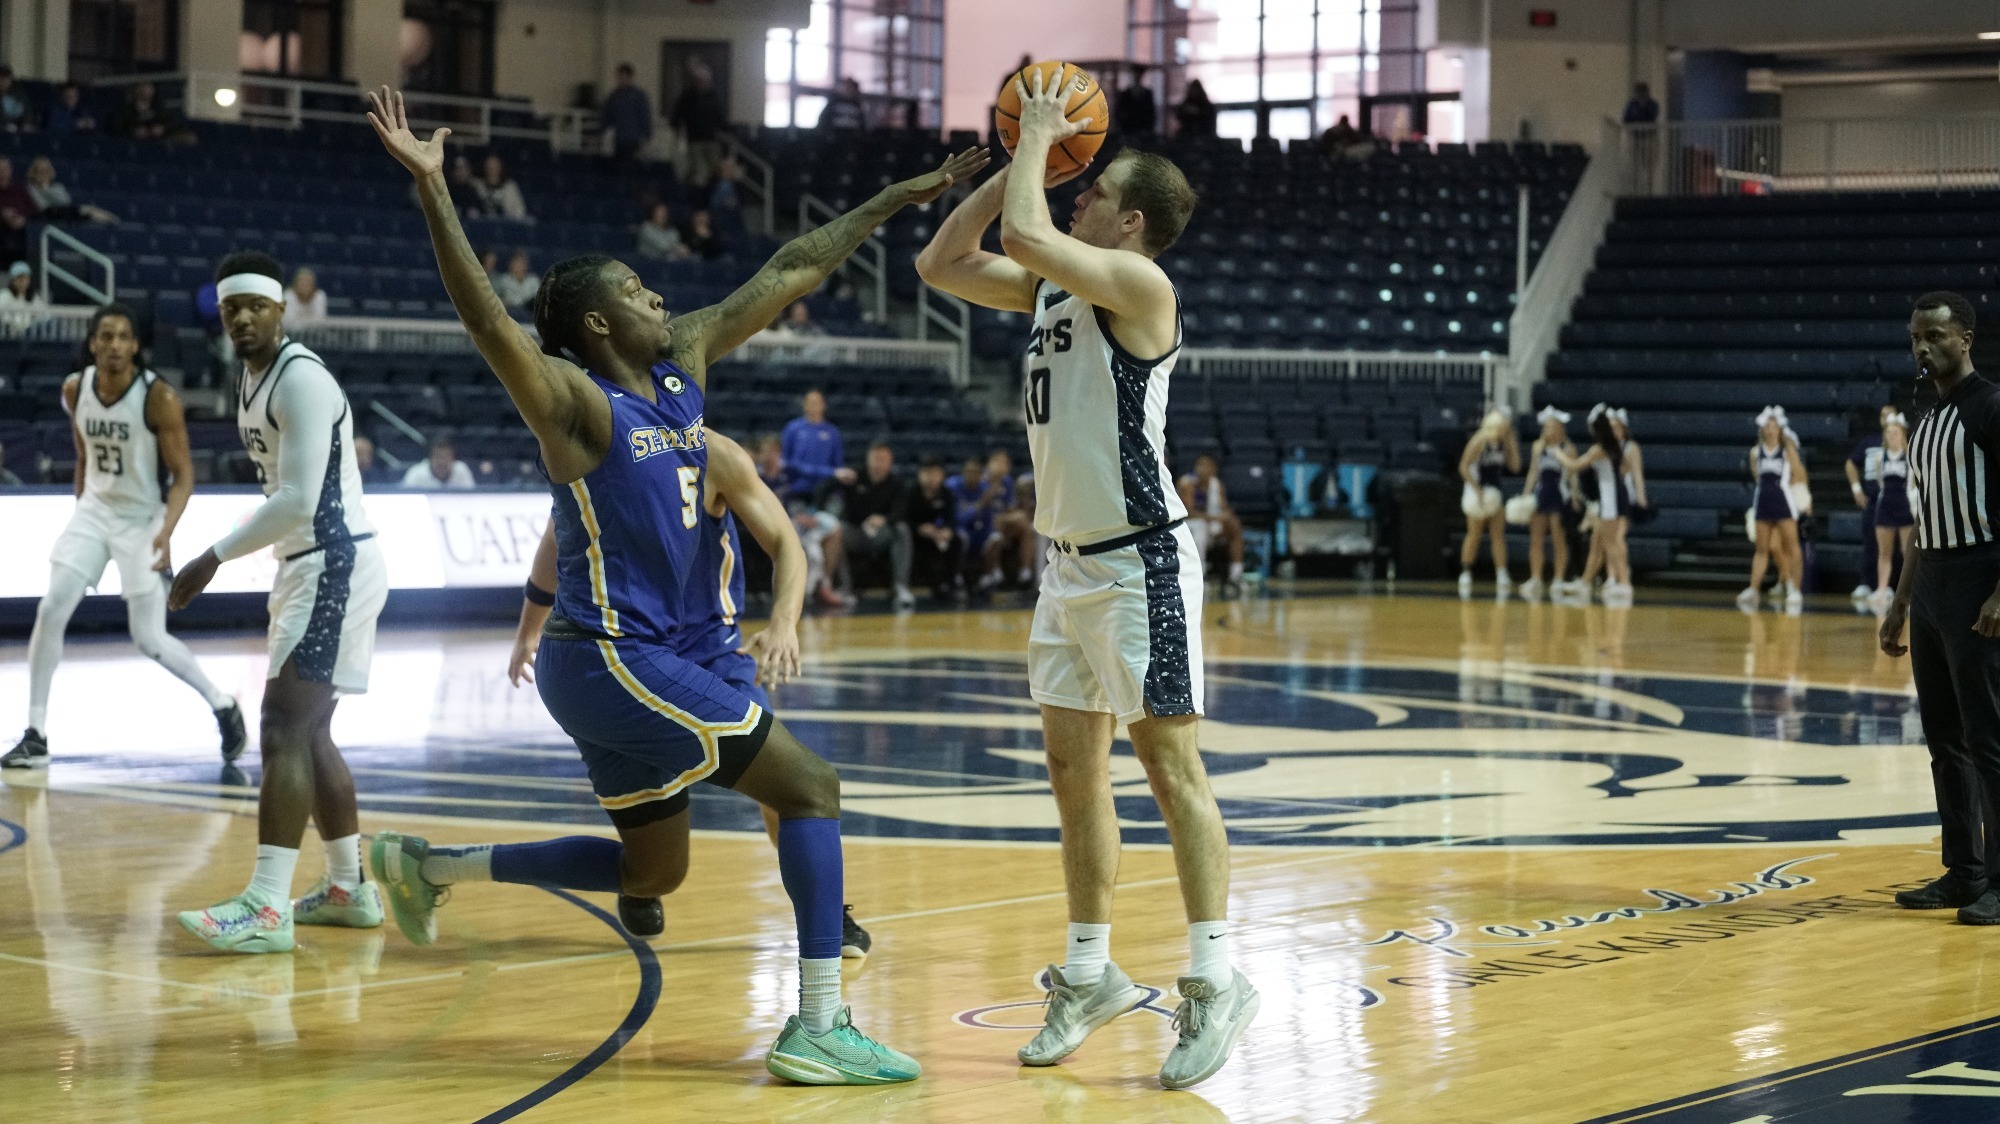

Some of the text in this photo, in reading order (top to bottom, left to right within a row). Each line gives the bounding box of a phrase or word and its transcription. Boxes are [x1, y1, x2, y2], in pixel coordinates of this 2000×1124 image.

[86, 418, 129, 441] UAFS
[241, 427, 268, 453] AFS
[94, 444, 123, 475] 23
[677, 467, 699, 529] 5
[1386, 950, 1624, 989] GAYLE
